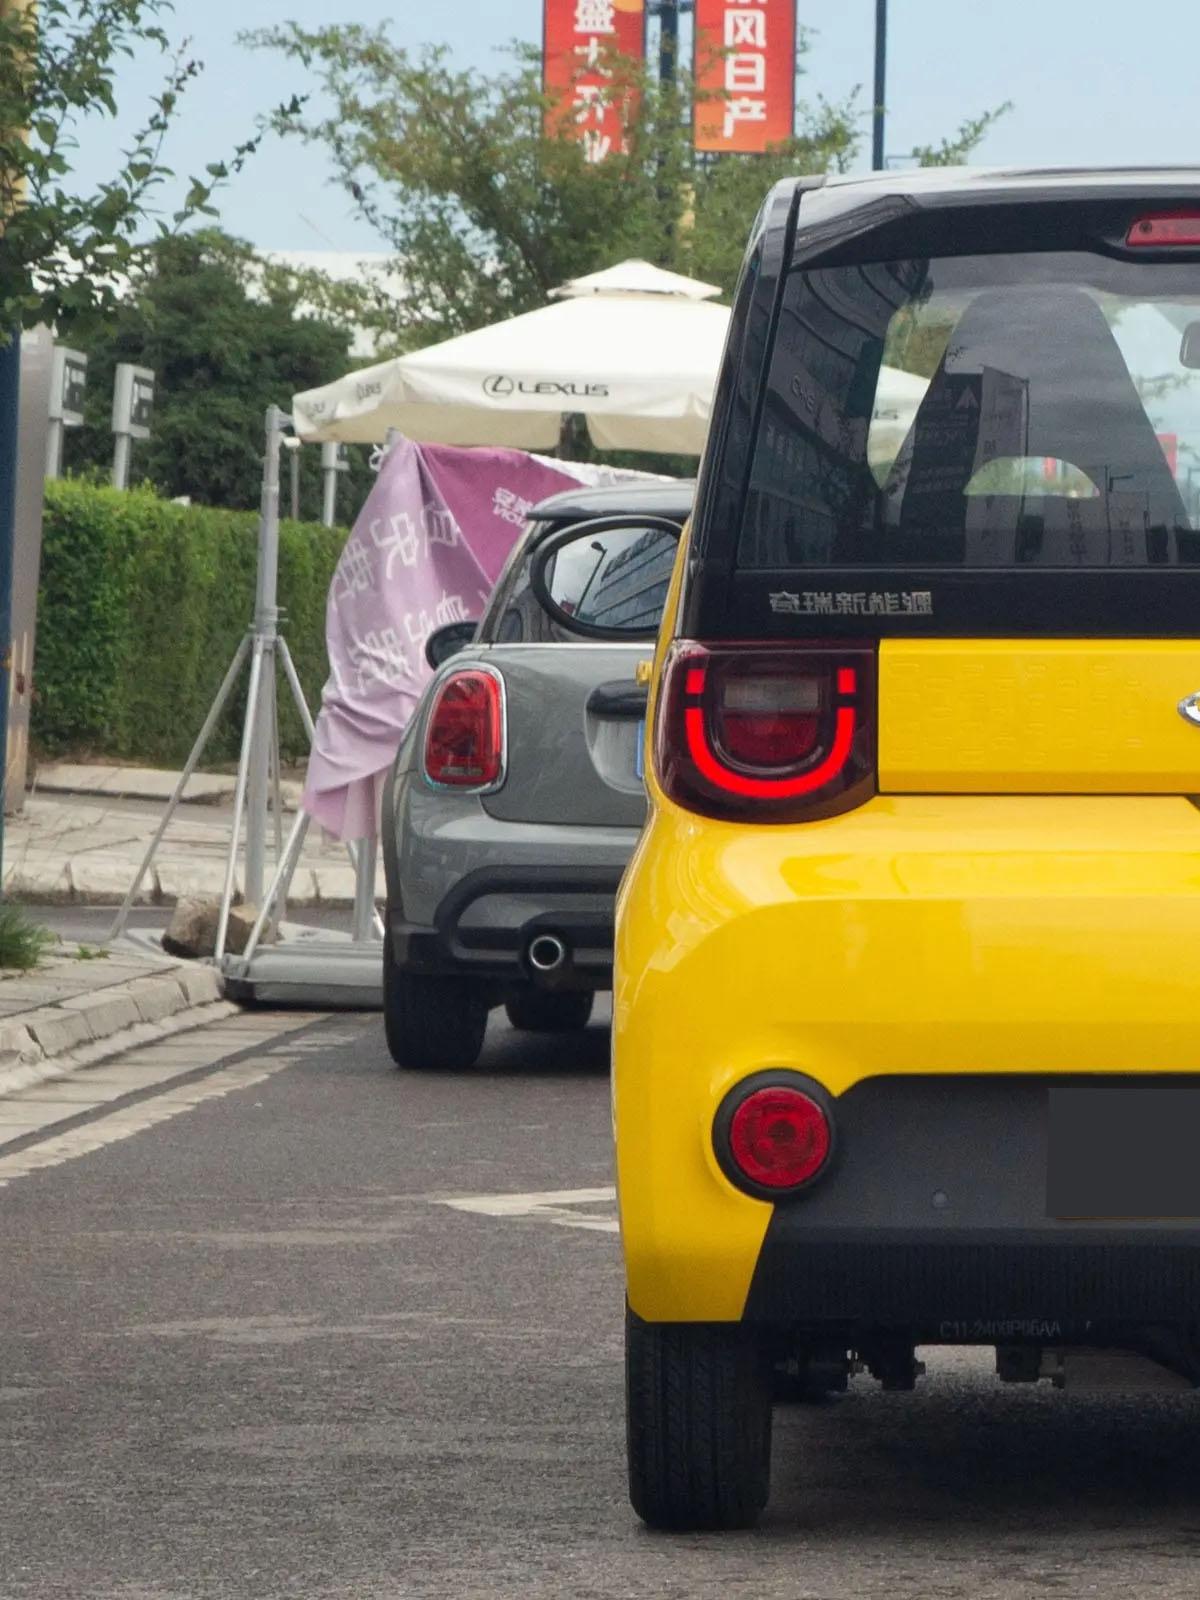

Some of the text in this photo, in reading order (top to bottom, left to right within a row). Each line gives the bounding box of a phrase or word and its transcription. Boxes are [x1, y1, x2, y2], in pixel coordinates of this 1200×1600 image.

[723, 0, 767, 138] 风日产
[518, 381, 608, 397] LEXUS
[769, 591, 933, 615] 奇瑞新能源
